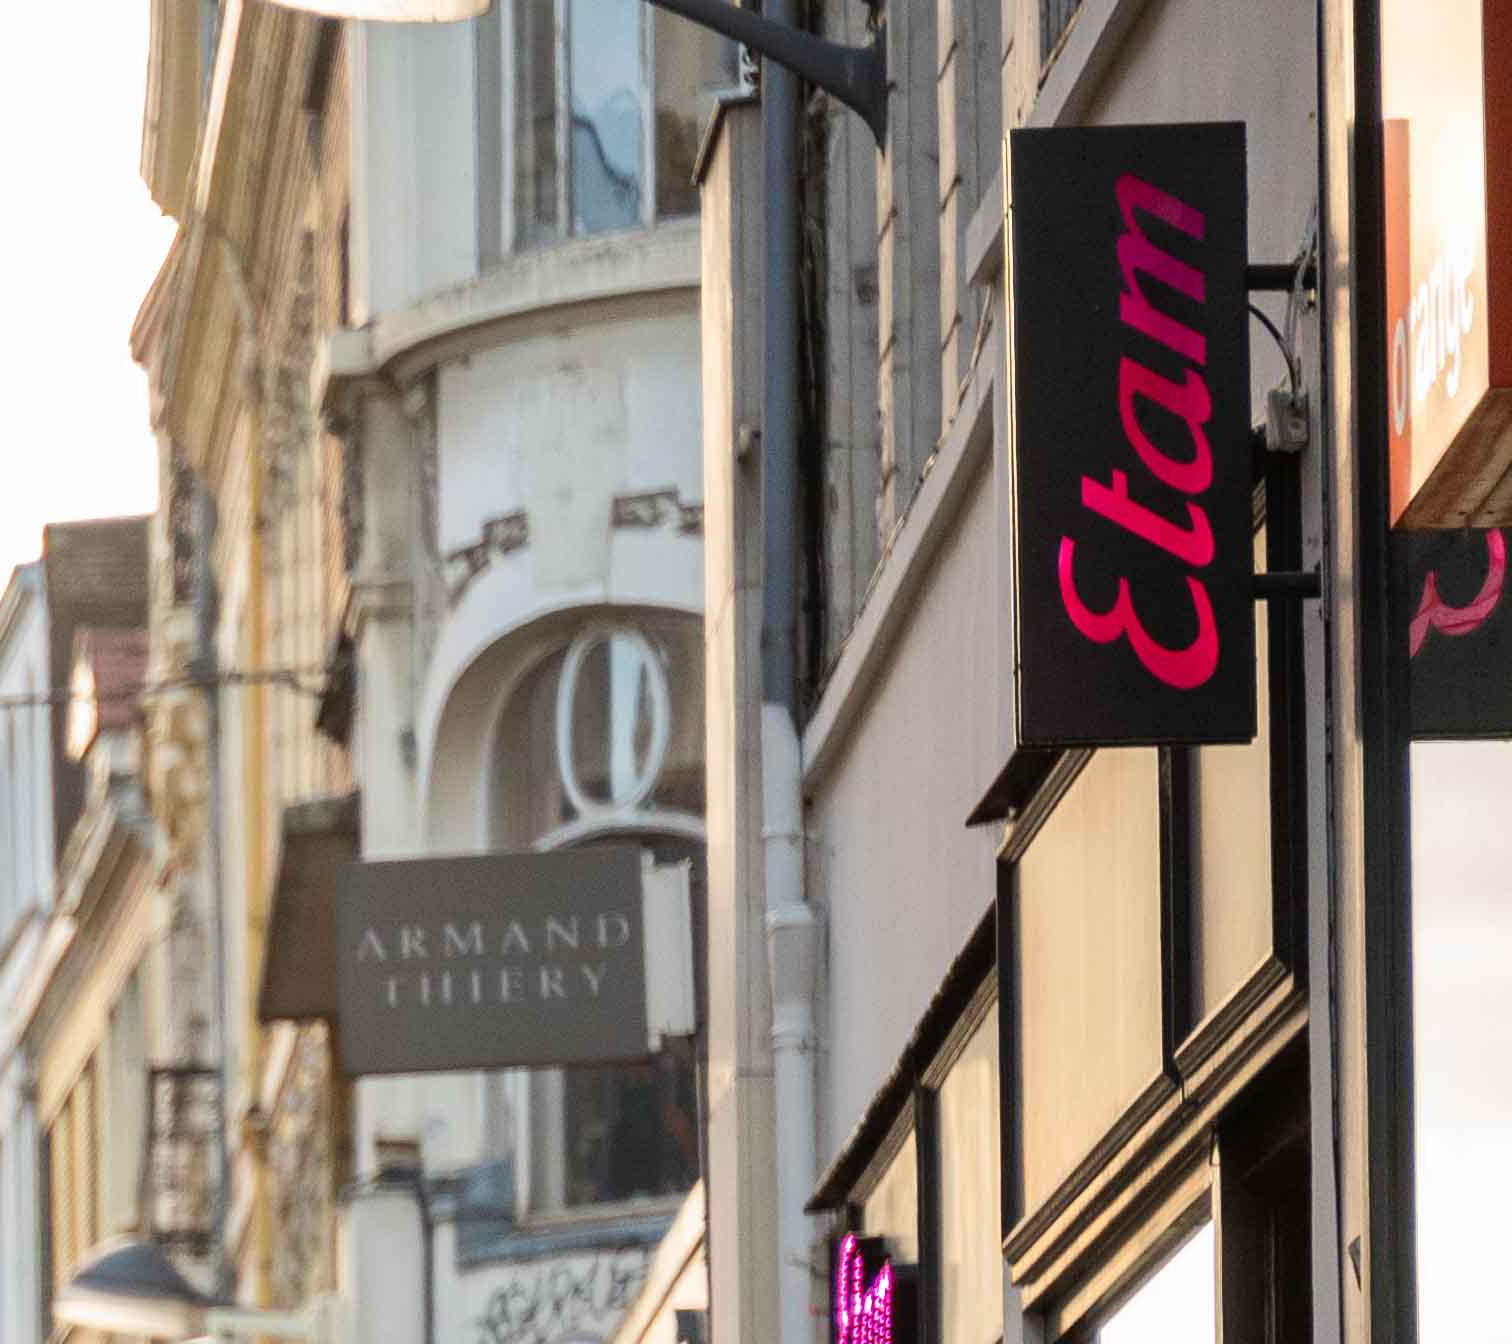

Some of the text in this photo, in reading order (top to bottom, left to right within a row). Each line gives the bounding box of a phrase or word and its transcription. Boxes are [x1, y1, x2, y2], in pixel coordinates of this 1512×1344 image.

[1058, 173, 1219, 689] Etam
[358, 913, 631, 961] ARMAND
[383, 963, 609, 1007] THIERY
